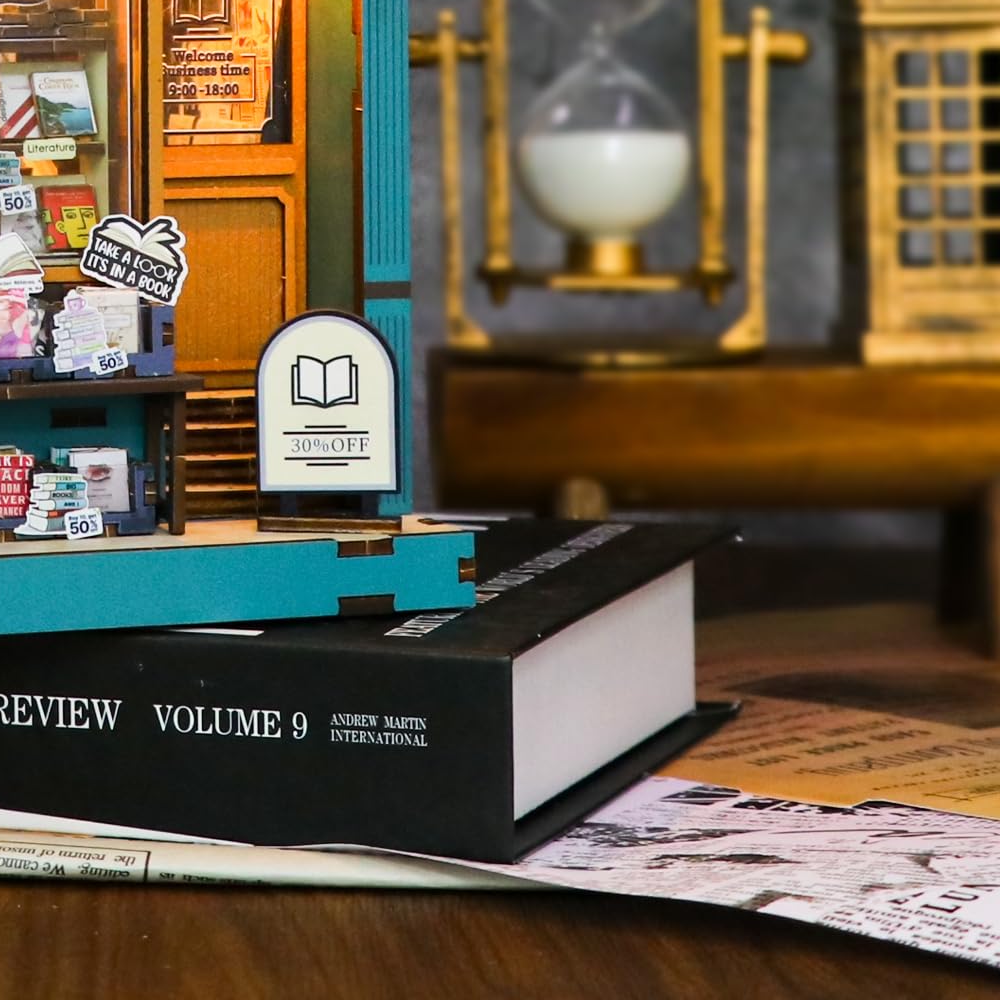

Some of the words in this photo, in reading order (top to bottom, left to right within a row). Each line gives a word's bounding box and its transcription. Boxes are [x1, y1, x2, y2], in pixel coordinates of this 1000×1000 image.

[174, 50, 234, 63] Welcome
[220, 63, 250, 76] time
[27, 143, 75, 154] Literature
[94, 237, 121, 260] TAKE
[122, 251, 131, 265] A
[133, 255, 177, 283] LOOK
[109, 263, 126, 279] IN
[126, 271, 136, 285] A
[138, 275, 172, 299] BOOK
[18, 455, 33, 467] IS
[153, 704, 282, 738] VOLUME
[292, 711, 308, 740] 9
[330, 713, 379, 728] ANDREW
[383, 715, 427, 730] MARTIN
[330, 728, 428, 747] INTERNATIONAL
[42, 862, 65, 877] We
